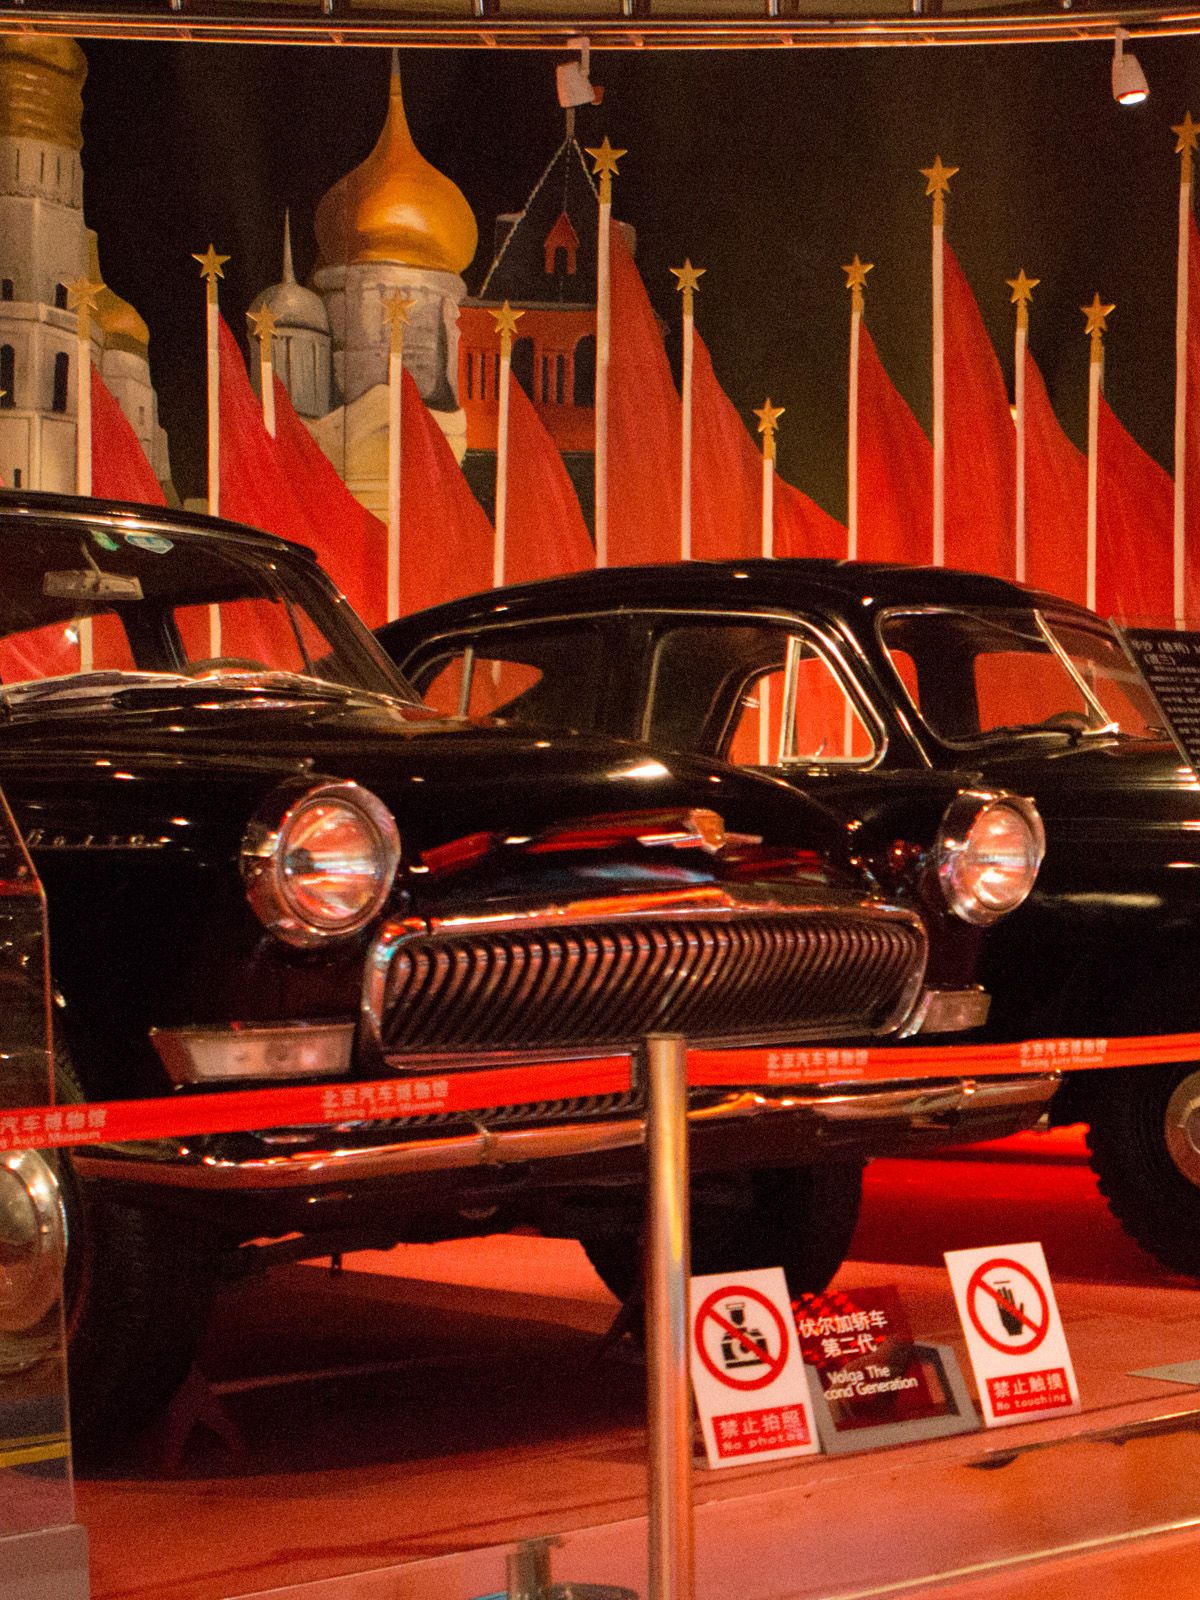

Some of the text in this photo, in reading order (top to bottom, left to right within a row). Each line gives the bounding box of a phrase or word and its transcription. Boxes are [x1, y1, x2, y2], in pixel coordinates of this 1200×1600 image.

[800, 1310, 888, 1338] 伏尔加轿车
[821, 1333, 878, 1358] 第二代
[827, 1365, 890, 1385] Volga The
[856, 1377, 918, 1395] Generation
[993, 1373, 1063, 1399] 禁止触摸
[996, 1394, 1067, 1411] No touching
[719, 1409, 803, 1440] 禁止拍照
[722, 1441, 742, 1452] No
